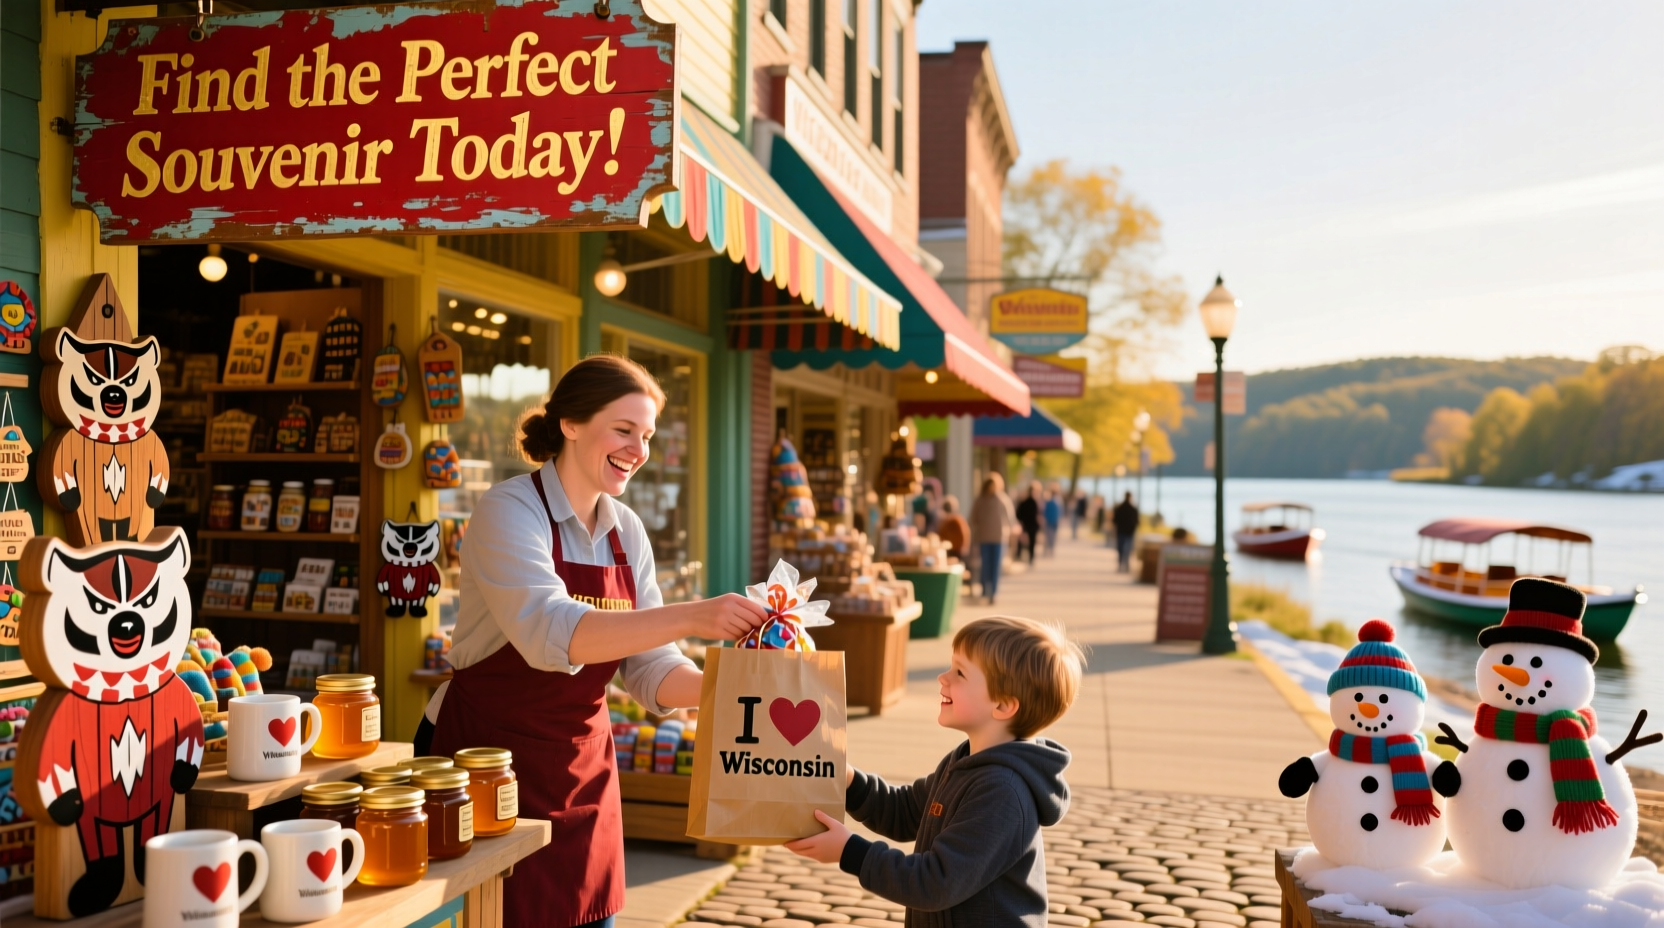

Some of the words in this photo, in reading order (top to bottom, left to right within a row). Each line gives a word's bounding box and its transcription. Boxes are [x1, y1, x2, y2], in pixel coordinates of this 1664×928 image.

[133, 46, 270, 116] Find
[287, 43, 381, 108] the
[395, 32, 618, 104] Perfect
[121, 123, 393, 198] Souvenir
[410, 108, 626, 195] Today!
[735, 696, 762, 744] I
[719, 751, 835, 778] Wisconsin
